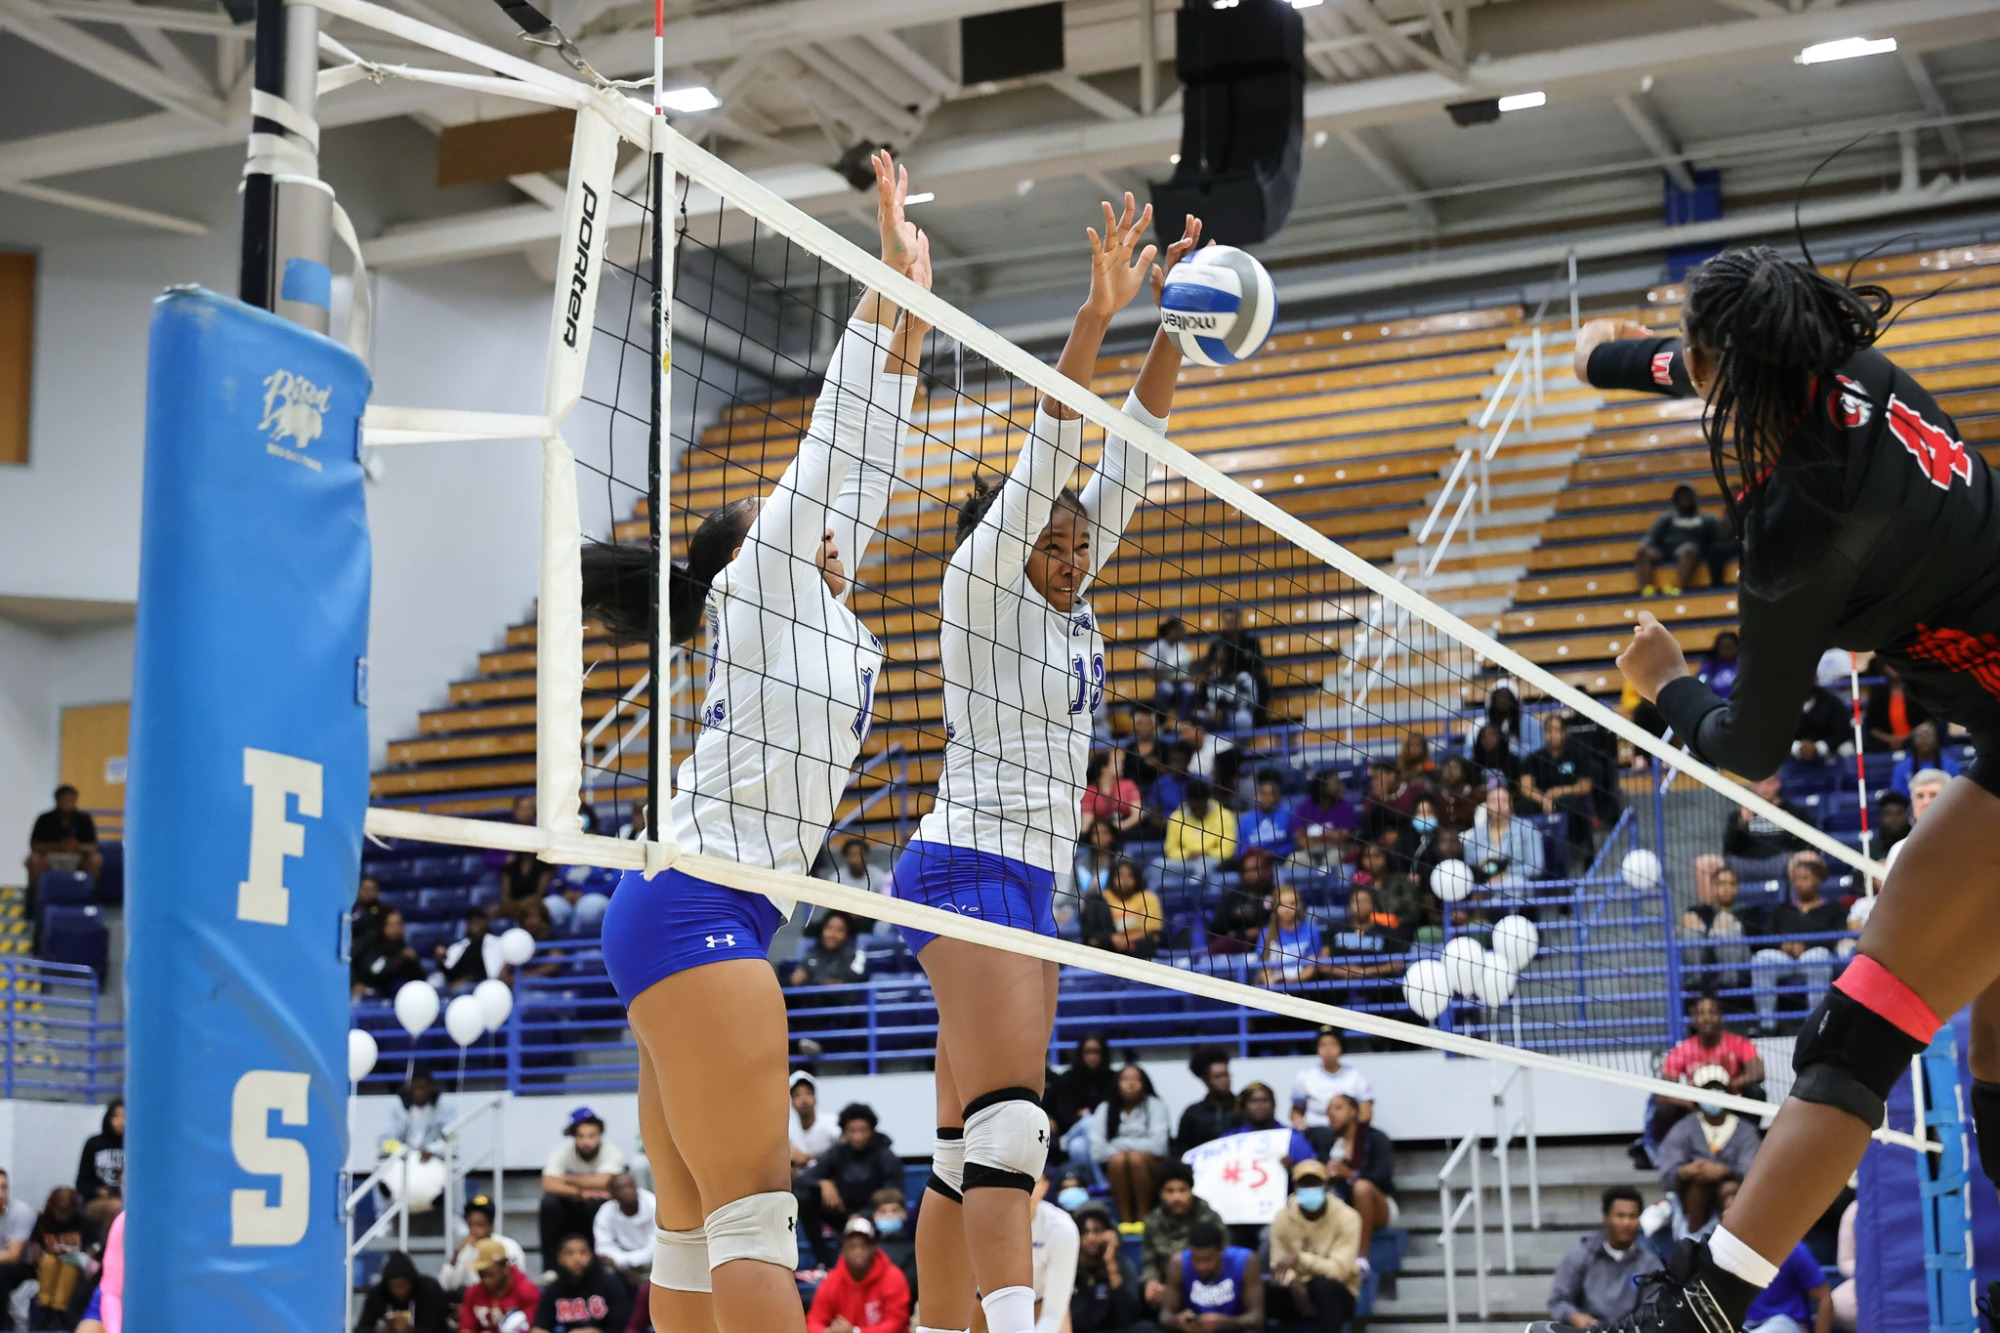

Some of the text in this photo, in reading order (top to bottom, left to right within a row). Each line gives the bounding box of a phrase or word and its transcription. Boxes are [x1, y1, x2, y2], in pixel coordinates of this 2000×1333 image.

[1885, 393, 1973, 491] 4
[236, 747, 323, 926] F
[231, 1070, 311, 1246] S
[1222, 1158, 1269, 1190] #5
